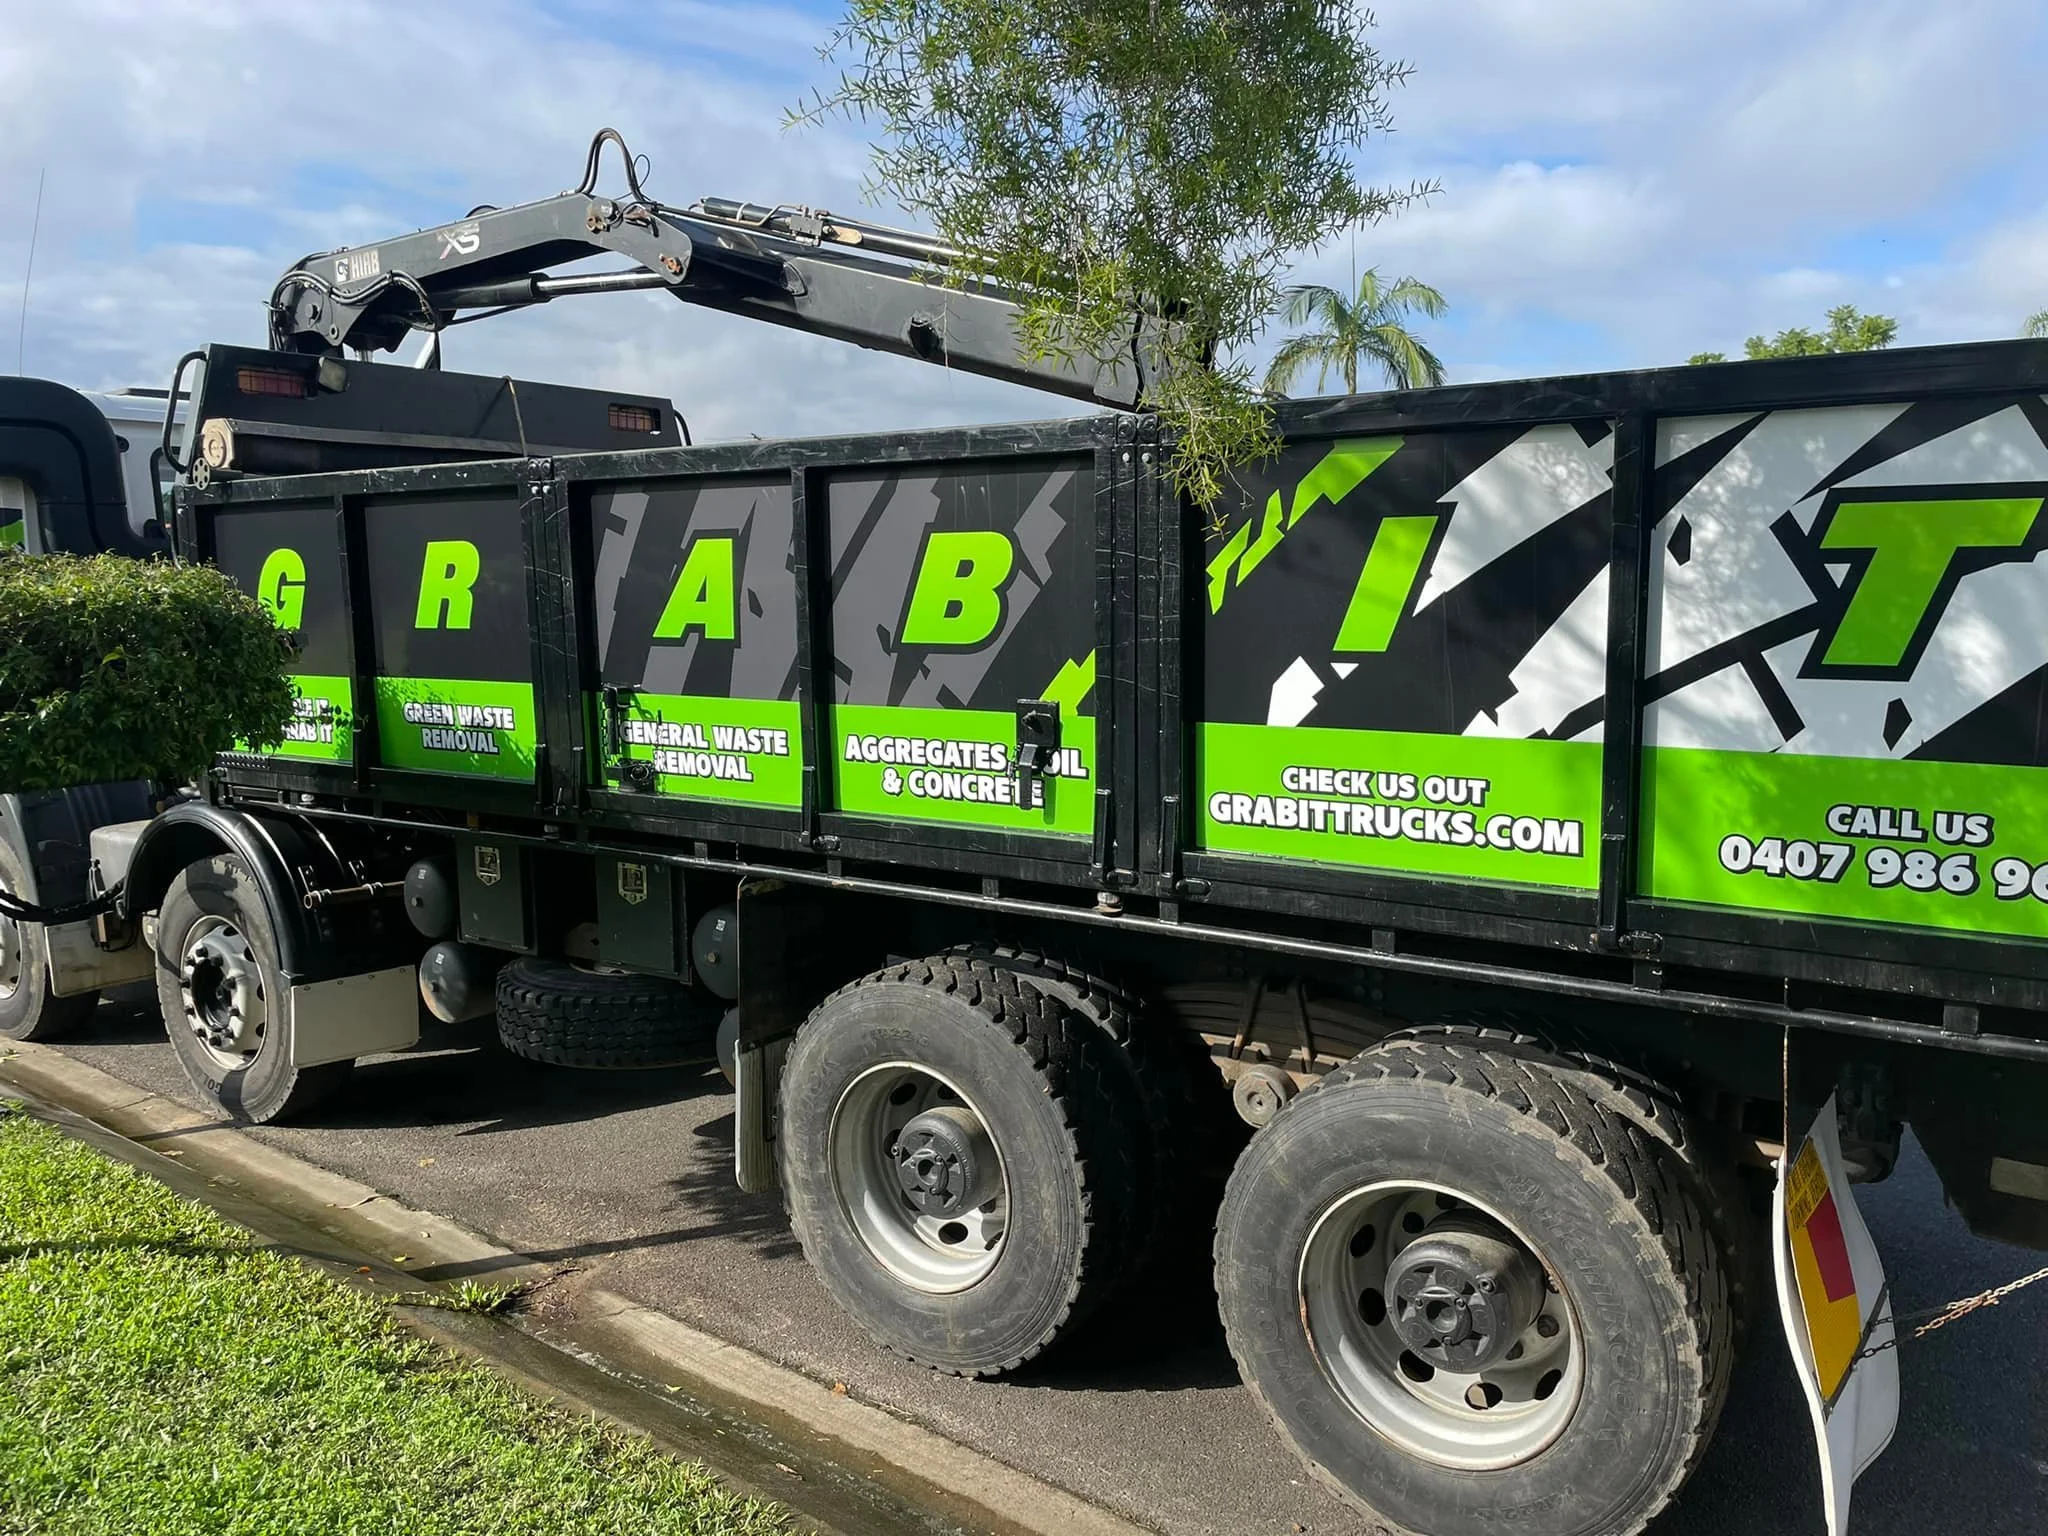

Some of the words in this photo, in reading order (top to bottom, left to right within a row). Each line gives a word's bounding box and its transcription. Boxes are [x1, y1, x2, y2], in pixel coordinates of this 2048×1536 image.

[403, 702, 455, 726] GREEN
[456, 705, 515, 731] WASTE
[422, 728, 500, 755] REMOVAL
[620, 720, 710, 749] GENERAL
[712, 725, 790, 755] WASTE
[653, 749, 754, 782] REMOVAL
[882, 767, 904, 797] &
[1281, 766, 1376, 799] CHECK
[1377, 772, 1418, 801] US
[1423, 777, 1490, 808] OUT
[1208, 792, 1584, 858] GRABITTRUCKS.COM
[1826, 805, 1928, 842] CALL
[1934, 811, 1995, 848] US
[1719, 834, 1856, 884] 0407
[1866, 847, 1980, 896] 986
